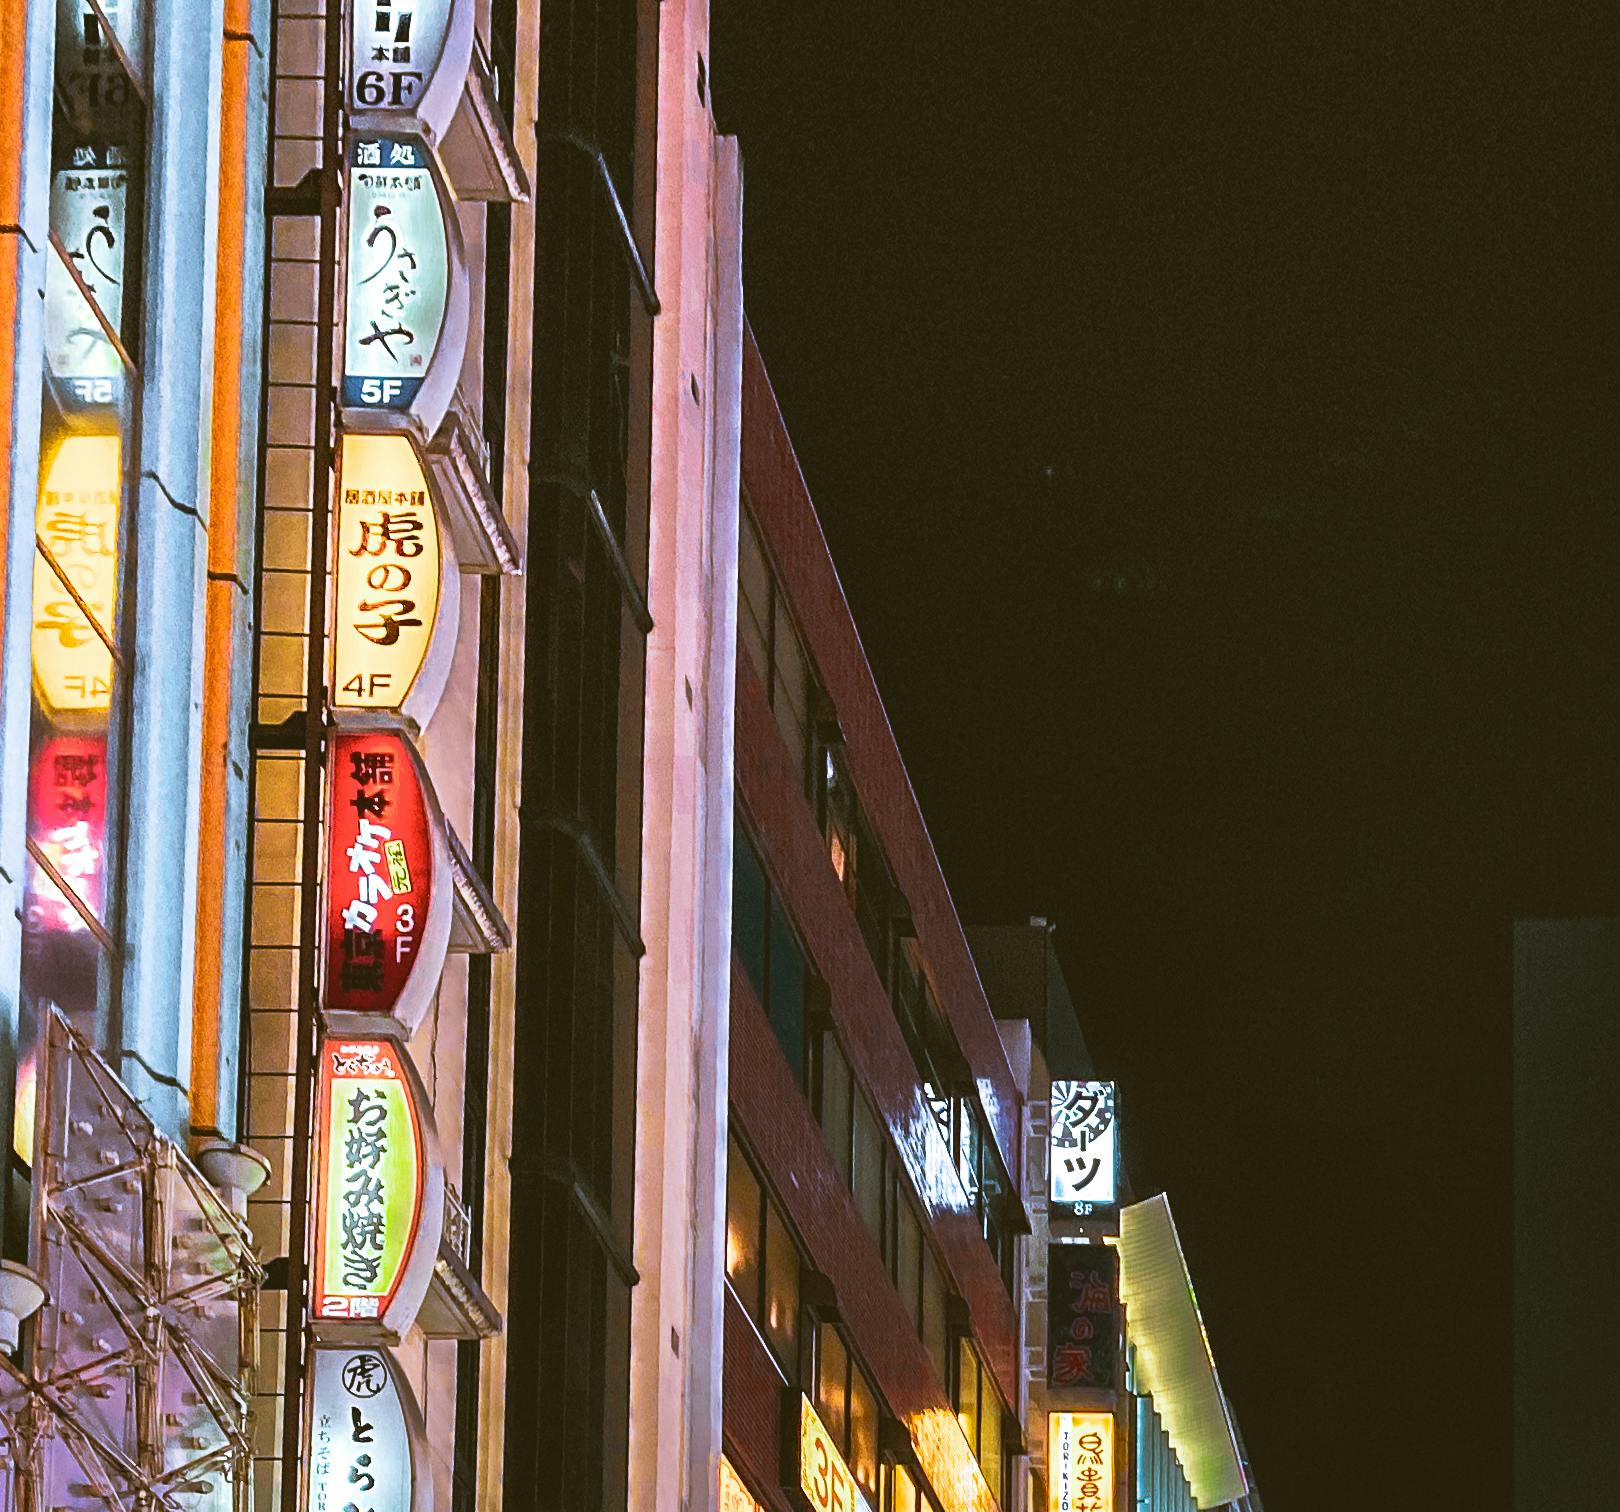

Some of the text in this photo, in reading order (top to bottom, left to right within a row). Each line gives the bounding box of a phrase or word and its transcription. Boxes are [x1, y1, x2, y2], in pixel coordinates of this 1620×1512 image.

[356, 70, 424, 106] 6F
[357, 142, 415, 164] 酒処
[358, 205, 415, 361] うさぎや
[361, 379, 401, 403] 5F
[350, 512, 423, 644] 虎の子
[342, 674, 392, 698] 4F
[395, 904, 415, 962] 3F
[1064, 1091, 1103, 1192] ダーツ
[340, 1088, 389, 1292] お好み焼き
[1074, 1201, 1092, 1215] 8F
[322, 1298, 379, 1317] 2階
